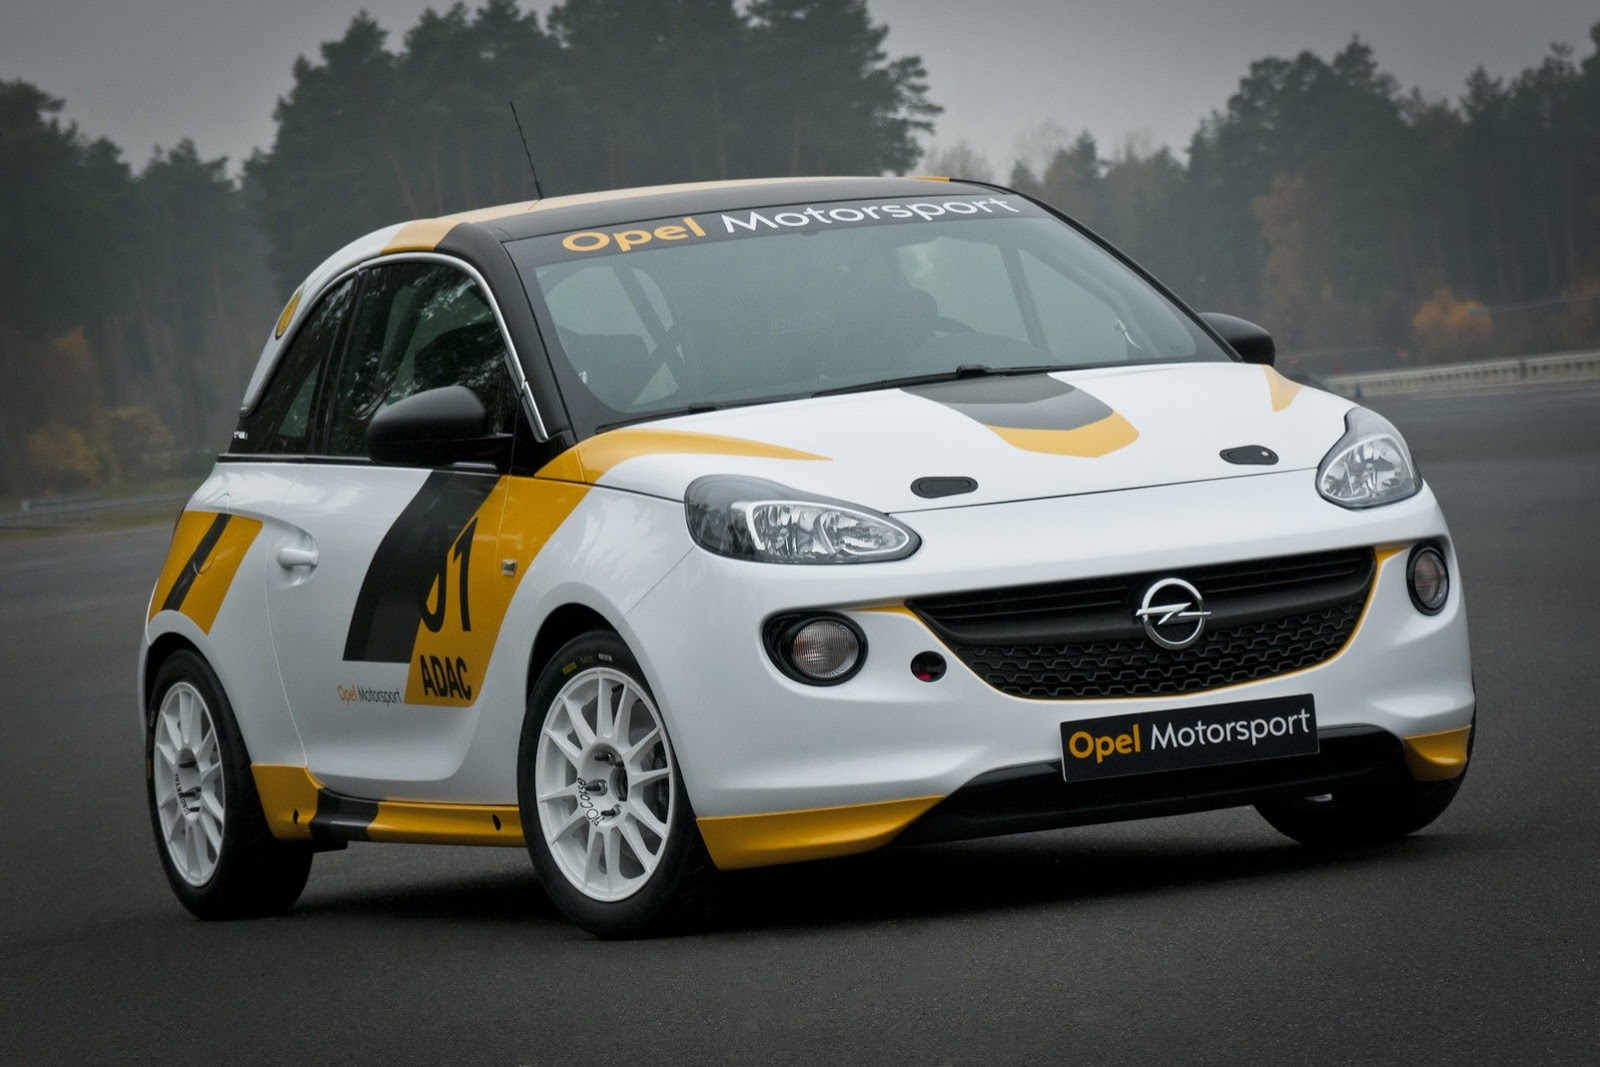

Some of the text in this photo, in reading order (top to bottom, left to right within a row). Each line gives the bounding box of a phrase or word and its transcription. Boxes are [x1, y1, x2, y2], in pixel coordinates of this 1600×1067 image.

[562, 196, 1020, 252] Opel Motorsport
[337, 684, 402, 707] Opel Motorsport
[420, 654, 472, 700] ADAC
[1069, 708, 1311, 764] Opel Motorsport
